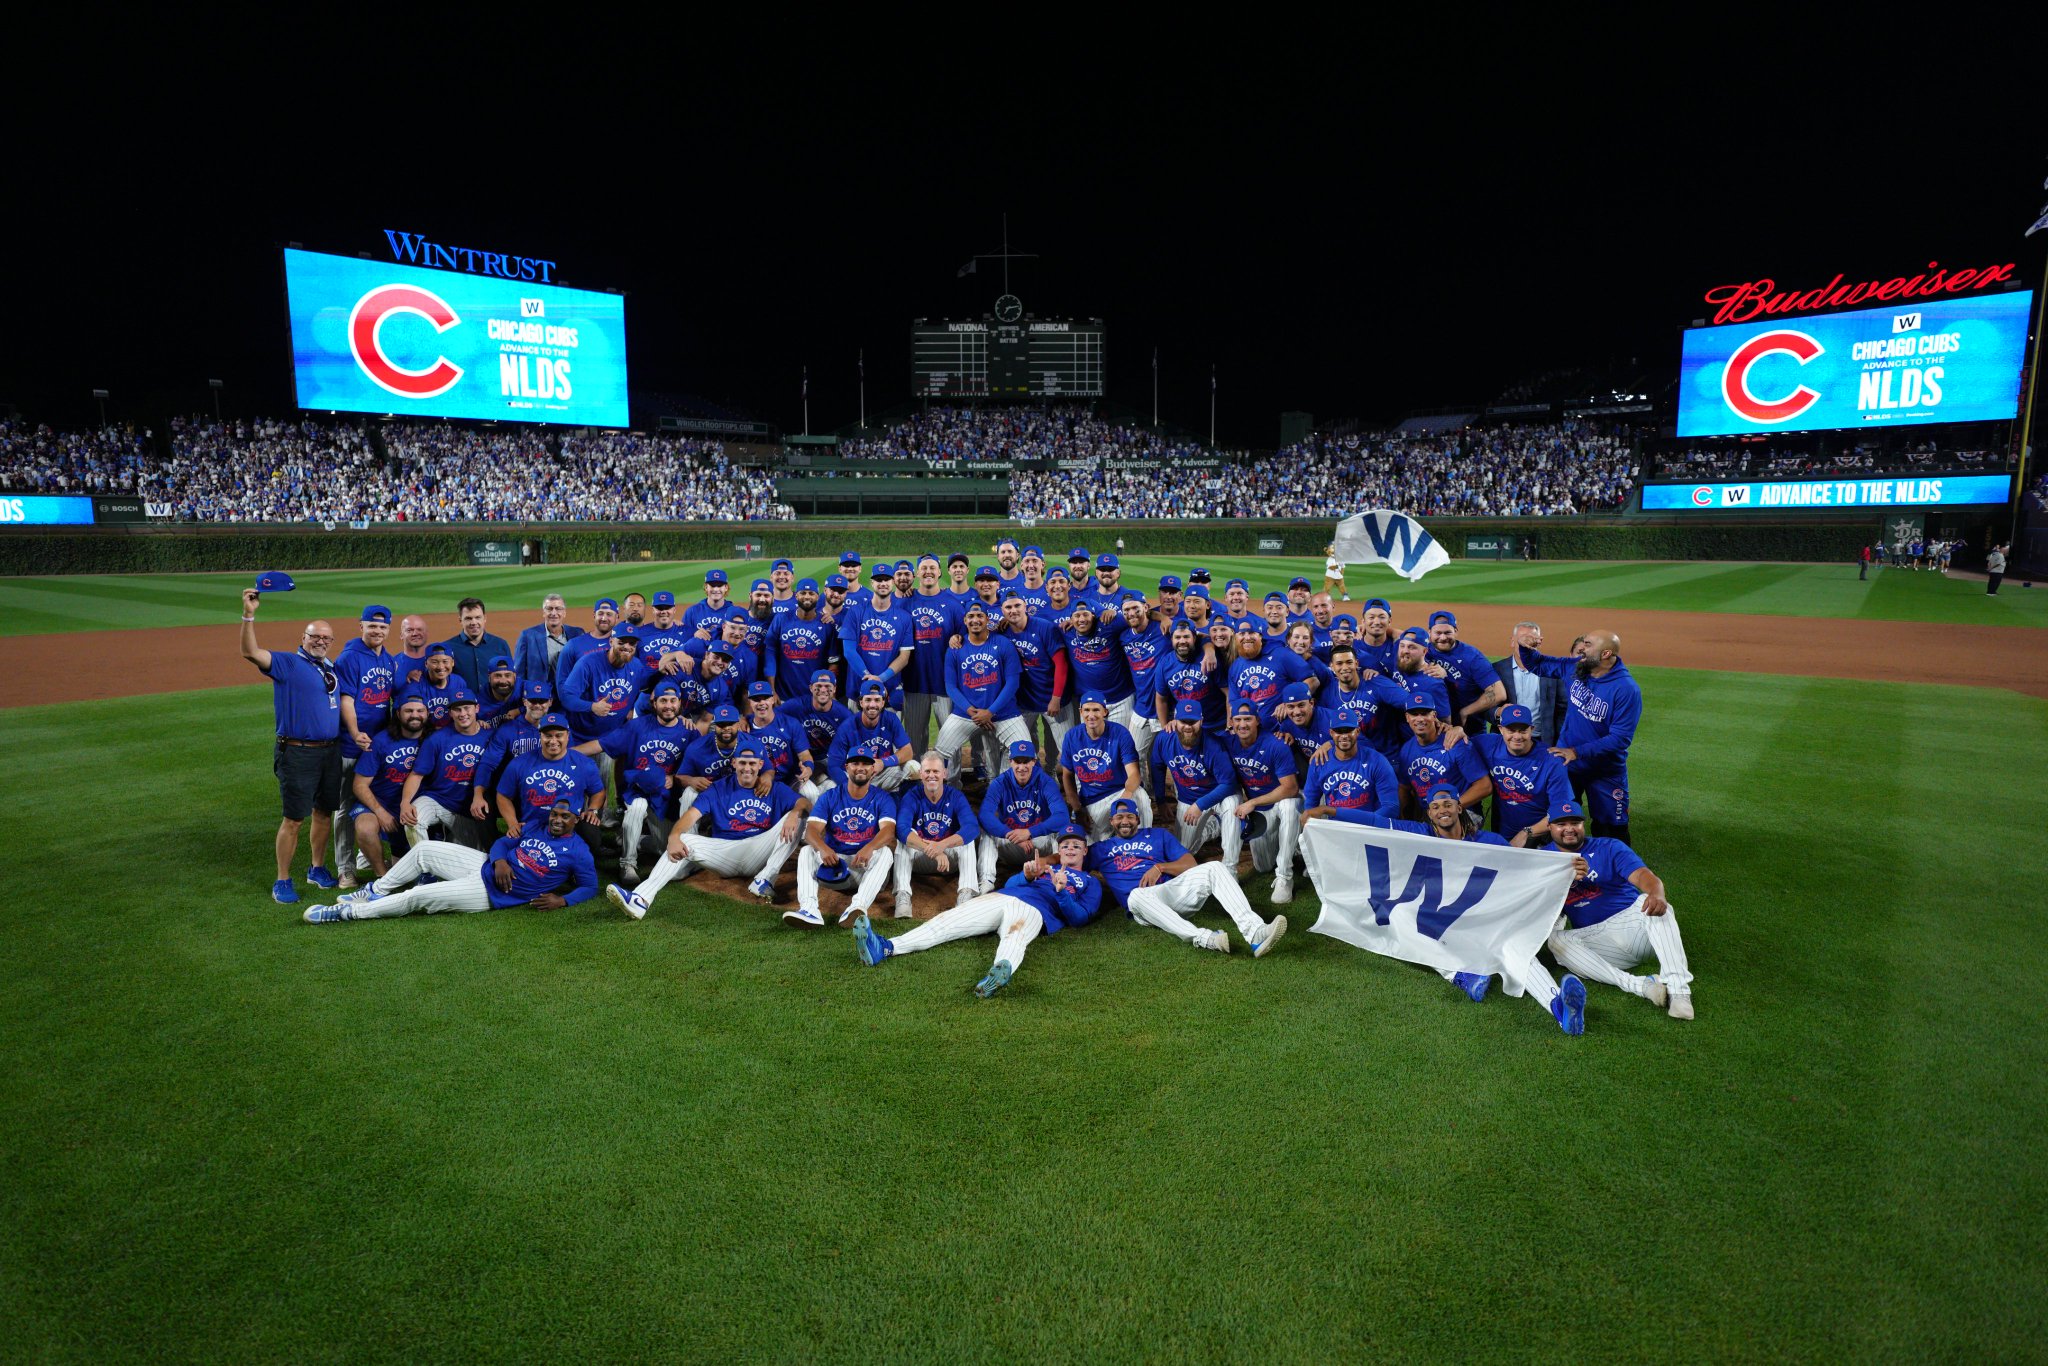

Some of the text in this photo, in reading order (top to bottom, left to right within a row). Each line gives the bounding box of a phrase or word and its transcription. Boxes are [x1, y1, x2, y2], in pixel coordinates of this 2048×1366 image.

[384, 229, 555, 282] WINTRUST
[1705, 262, 2015, 324] Budweiser
[526, 302, 539, 313] W
[949, 323, 989, 331] NATIONAL
[1029, 323, 1069, 331] AMERICAN
[1899, 315, 1916, 329] W
[348, 283, 464, 398] C
[488, 319, 578, 348] CHICAGO CUBS
[500, 343, 569, 357] ADVANCE TO THE
[1852, 333, 1960, 361] CHICAGO CUBS
[1862, 356, 1945, 370] ADVANCE TO THE
[500, 354, 572, 400] NLDS
[1722, 329, 1825, 424] C
[1858, 366, 1944, 411] NLDS
[926, 460, 956, 468] YETI
[972, 461, 1014, 469] tastytrade
[1105, 459, 1160, 469] Budweiser
[1182, 458, 1219, 466] Advocate
[1692, 487, 1712, 505] C
[1727, 488, 1745, 502] W
[1759, 481, 1942, 505] ADVANCE TO THE NLDS
[150, 504, 165, 514] W
[1260, 541, 1281, 549] Hefty
[1363, 513, 1434, 573] W
[860, 618, 896, 637] OCTOBER
[781, 628, 822, 647] OCTOBER
[961, 653, 998, 670] OCTOBER
[1237, 665, 1276, 688] OCTOBER
[598, 678, 633, 694] OCTOBER
[1072, 748, 1112, 766] OCTOBER
[1408, 757, 1446, 775] OCTOBER
[525, 768, 576, 790] OCTOBER
[1323, 771, 1370, 792] OCTOBER
[728, 799, 772, 817] OCTOBER
[832, 807, 875, 823] OCTOBER
[519, 838, 558, 868] OCTOBER
[1364, 844, 1498, 941] W
